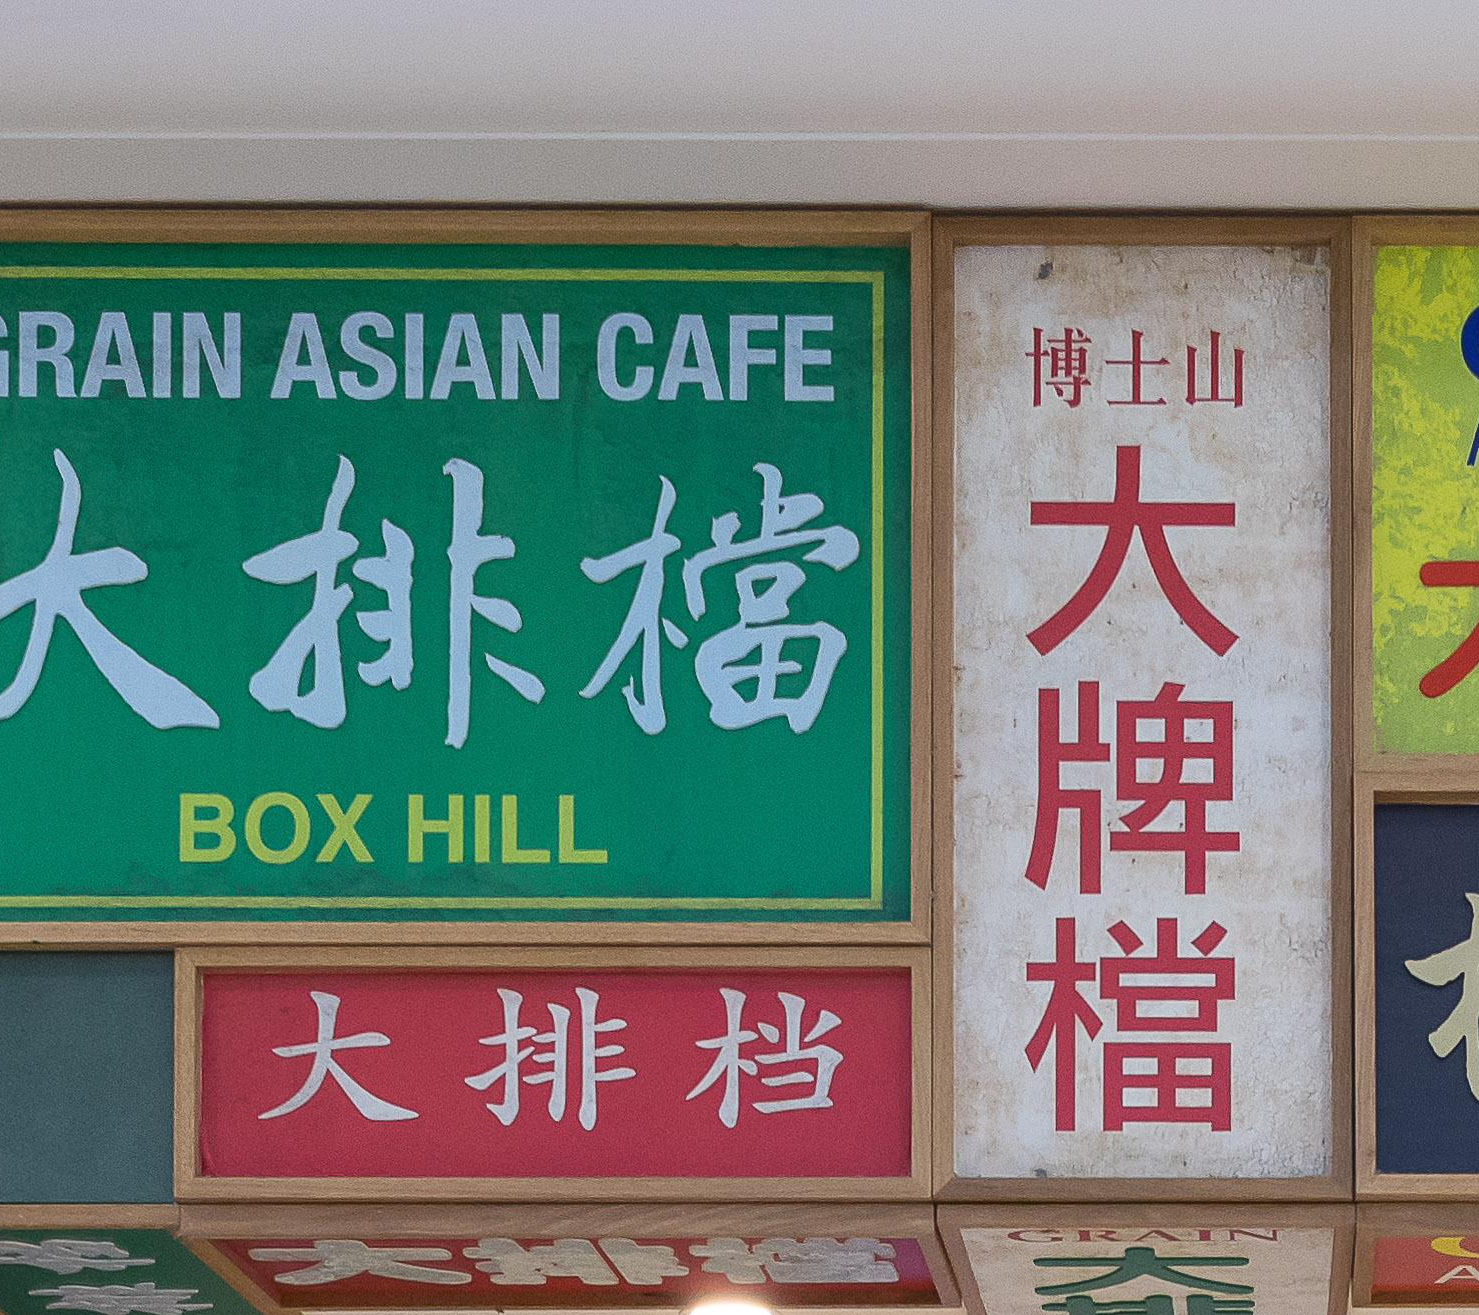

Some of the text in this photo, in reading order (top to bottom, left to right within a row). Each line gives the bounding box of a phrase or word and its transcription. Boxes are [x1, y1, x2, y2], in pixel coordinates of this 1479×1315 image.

[271, 312, 559, 400] ASIAN
[597, 313, 834, 401] CAFE
[1026, 328, 1244, 407] 博士山
[180, 792, 607, 863] BOX HILL
[1025, 445, 1240, 1131] 大牌檔
[259, 988, 843, 1130] 大排档
[1007, 1229, 1280, 1242] GRAIN
